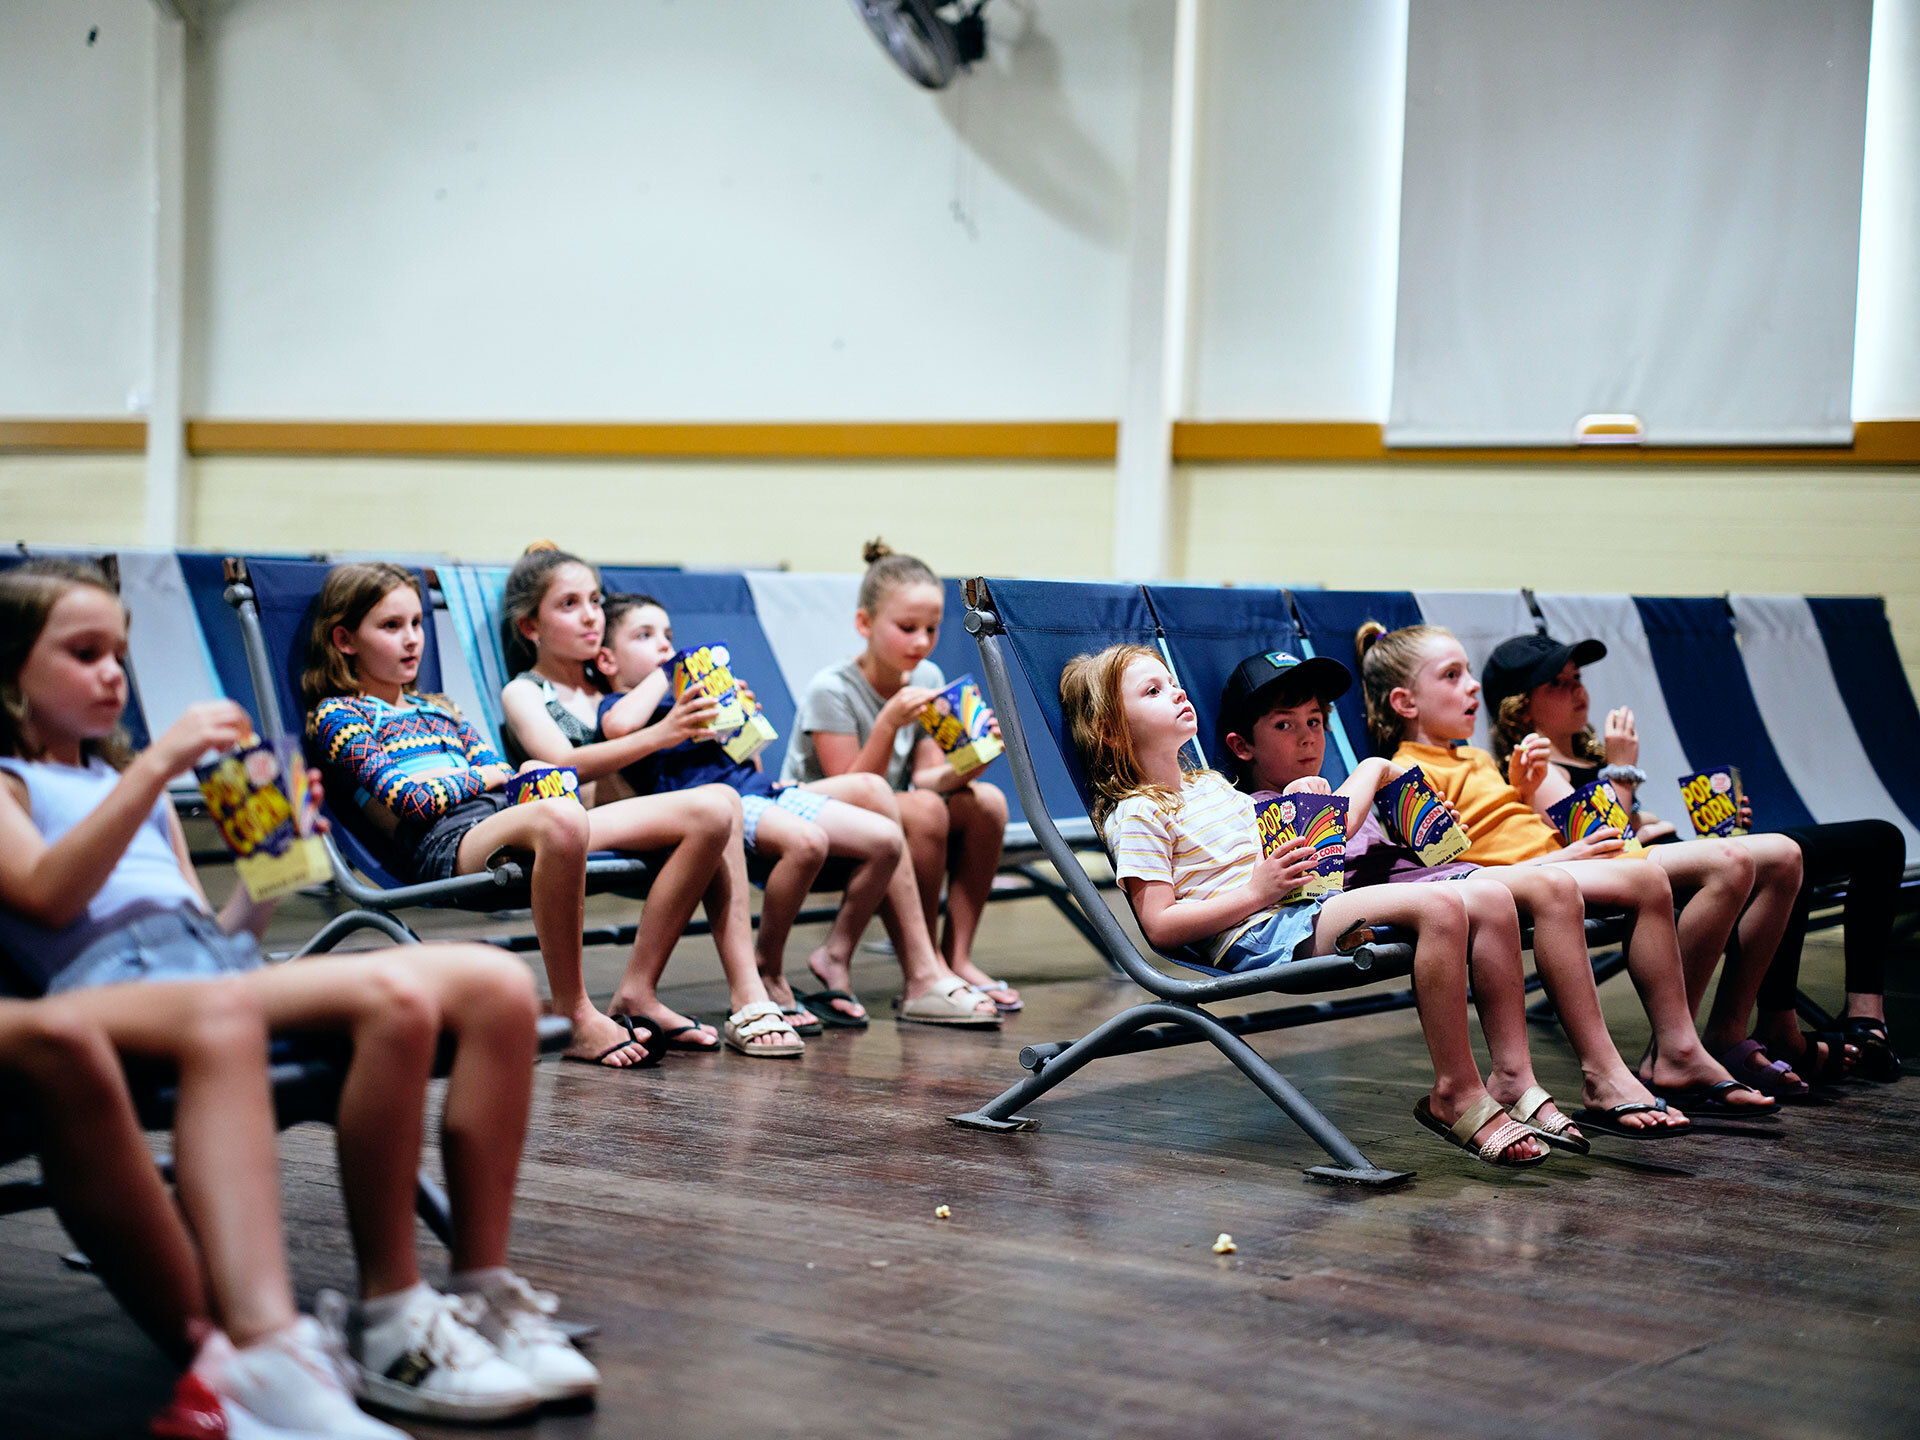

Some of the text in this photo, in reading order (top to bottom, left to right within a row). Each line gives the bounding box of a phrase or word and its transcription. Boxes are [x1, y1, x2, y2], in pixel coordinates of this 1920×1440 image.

[685, 646, 714, 681] POP
[201, 757, 247, 821] POP
[537, 769, 564, 799] POP
[1590, 784, 1611, 818] POP
[1681, 774, 1712, 811] POP
[221, 781, 292, 854] CORN
[1257, 802, 1282, 845] POP
[1415, 807, 1442, 845] POP CORN
[1691, 792, 1736, 833] CORN
[1320, 846, 1342, 857] CORN
